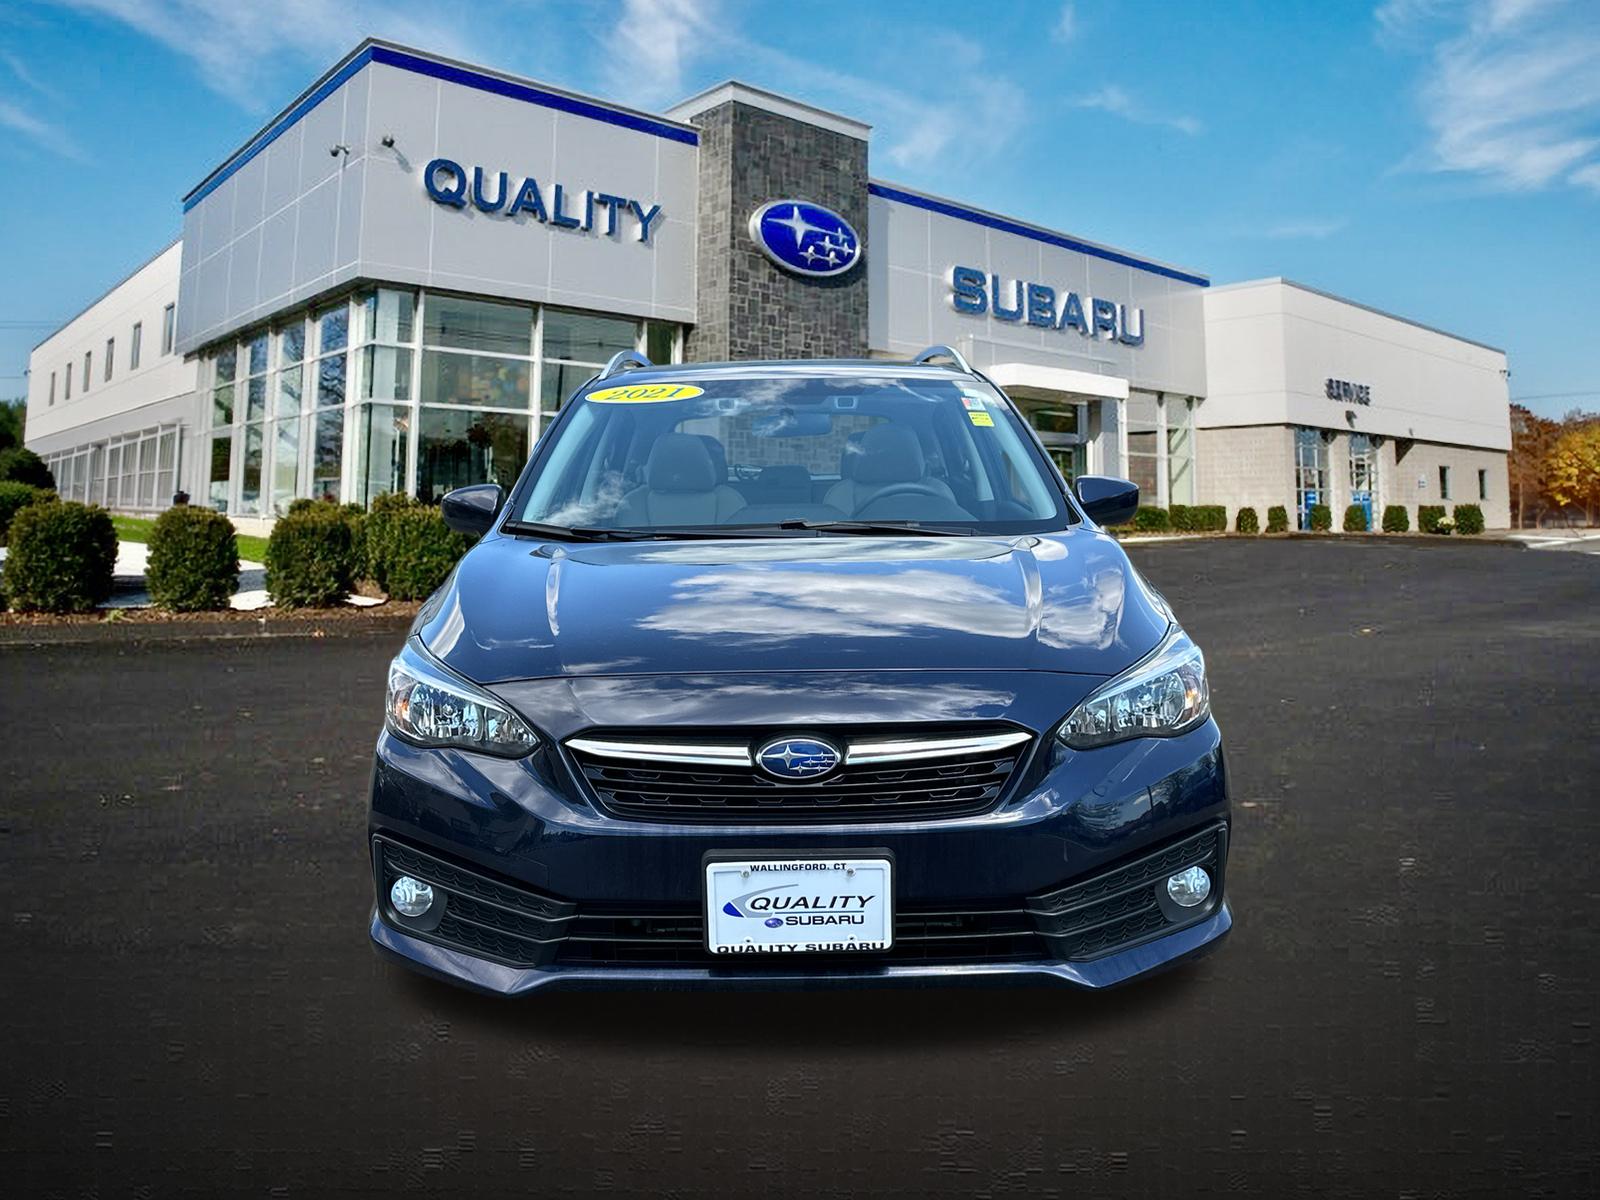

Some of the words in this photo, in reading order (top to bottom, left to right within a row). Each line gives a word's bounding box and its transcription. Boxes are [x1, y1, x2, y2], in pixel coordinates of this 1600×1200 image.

[424, 158, 661, 242] QUALITY
[951, 265, 1145, 346] SUBARU
[603, 387, 685, 401] 2021
[833, 863, 847, 871] CT
[750, 895, 875, 911] QUALITY
[785, 915, 865, 926] SUBARU
[716, 943, 798, 953] QUALITY
[805, 942, 885, 952] SUBARU
